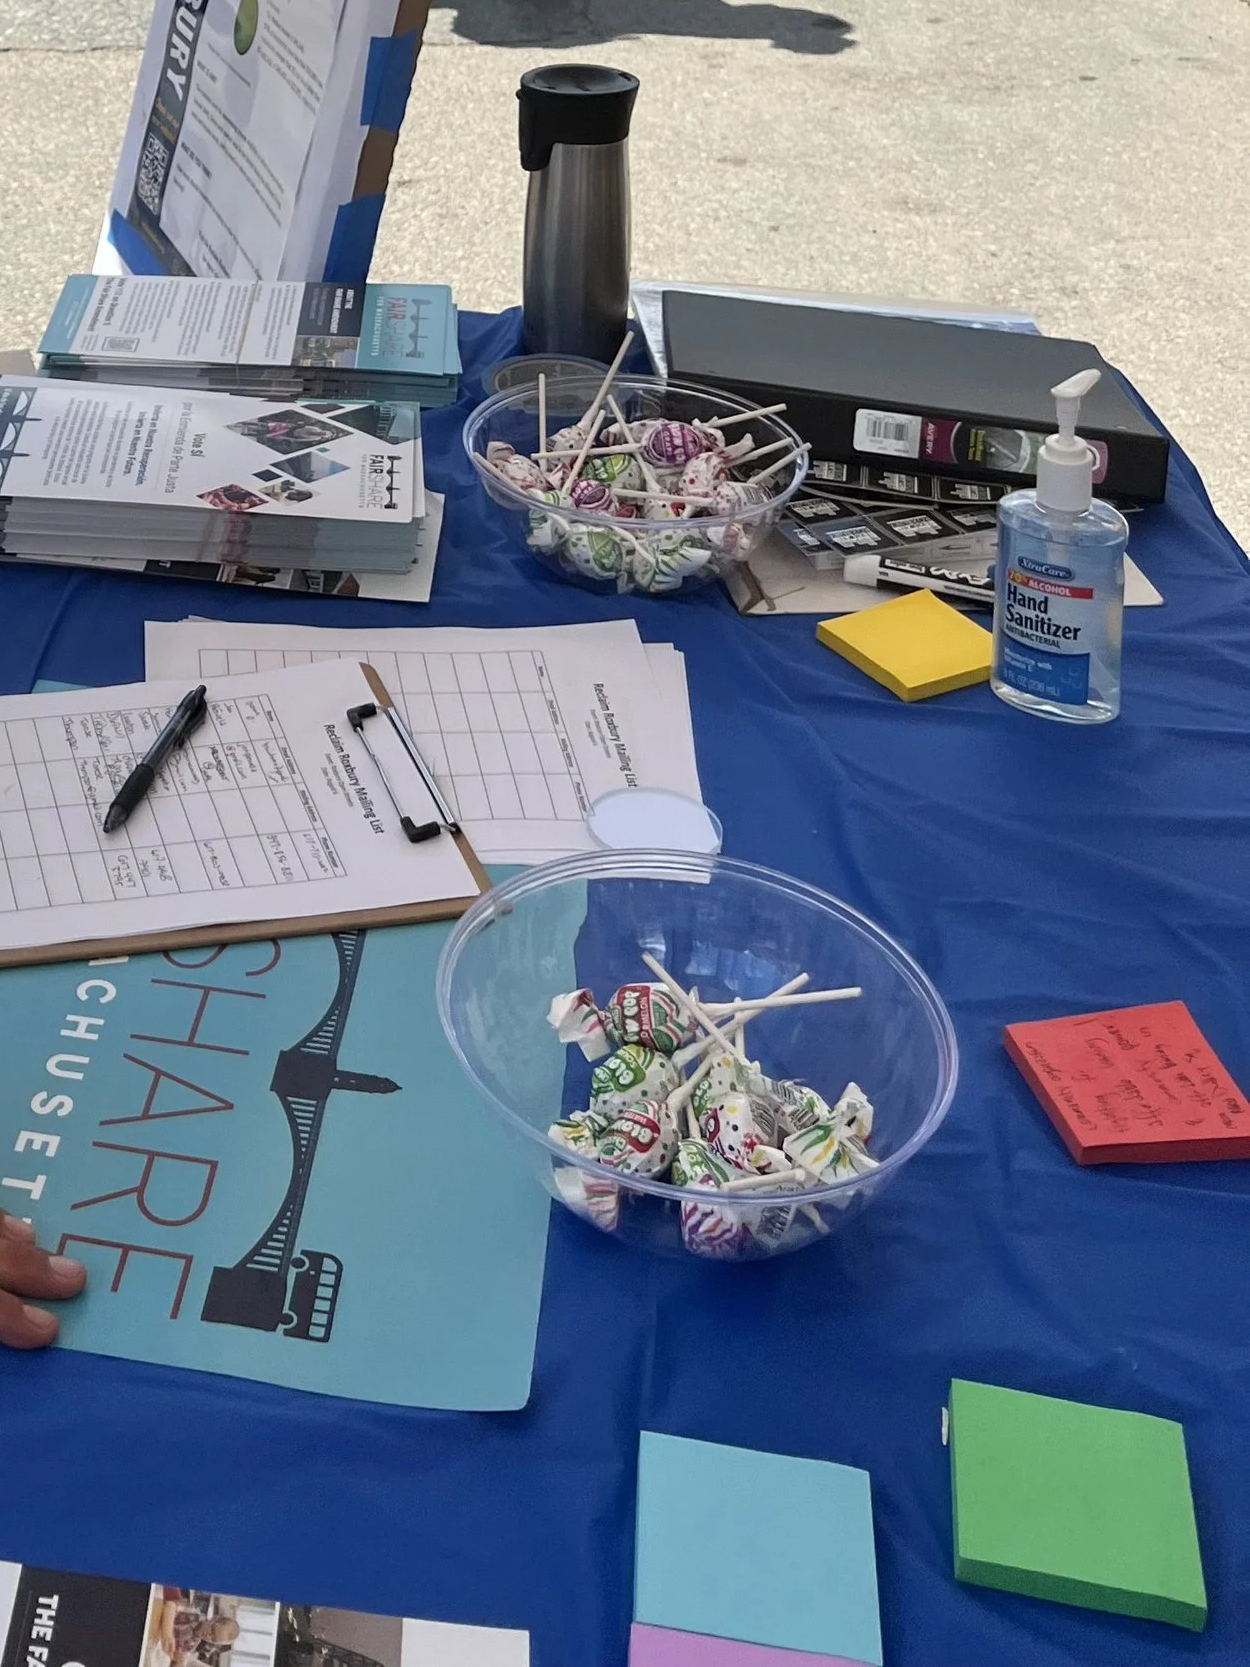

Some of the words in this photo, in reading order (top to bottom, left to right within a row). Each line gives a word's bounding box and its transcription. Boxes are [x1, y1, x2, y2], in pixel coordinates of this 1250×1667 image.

[172, 445, 184, 454] de
[191, 433, 206, 448] Vote
[924, 422, 934, 455] AVERY
[168, 455, 183, 472] Parte
[164, 473, 178, 493] Justa
[1020, 558, 1070, 579] XtraCare
[1007, 582, 1049, 614] Hand
[1028, 580, 1072, 597] ALCOHOL
[1006, 604, 1081, 641] Sanitizer
[1006, 623, 1061, 649] ANTIBACTERIAL
[593, 683, 609, 711] Reclaim
[603, 712, 620, 741] Roxbury
[614, 743, 631, 772] Mailing
[624, 773, 637, 787] List
[324, 724, 343, 753] Reclaim
[339, 753, 359, 786] Roxbury
[354, 787, 375, 818] Mailing
[369, 819, 384, 834] List
[1, 956, 130, 1225] CHUSET
[58, 937, 283, 1321] SHARE
[31, 1595, 58, 1640] THE
